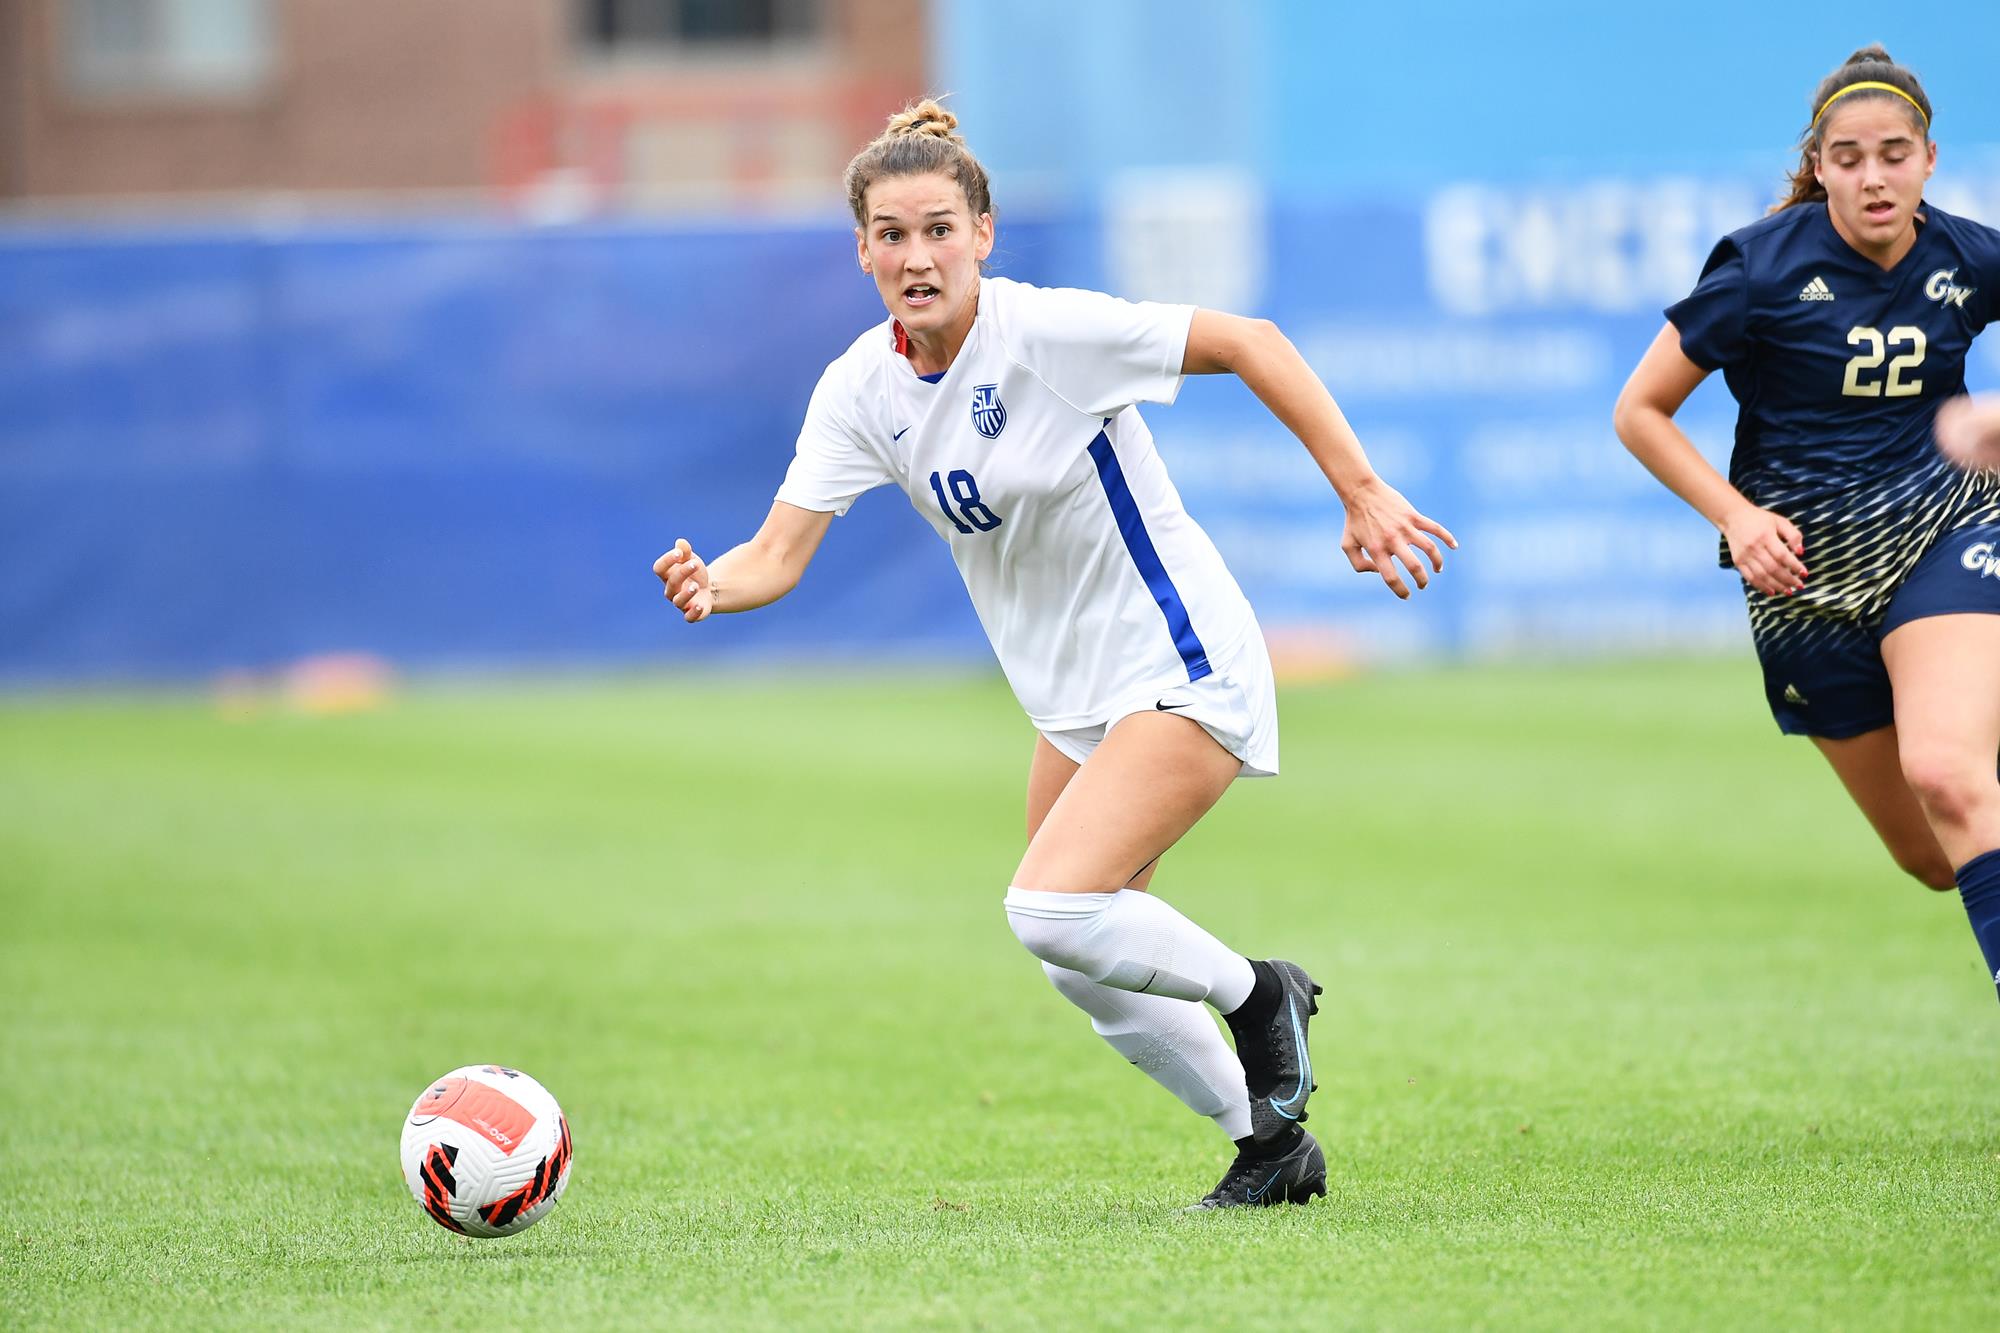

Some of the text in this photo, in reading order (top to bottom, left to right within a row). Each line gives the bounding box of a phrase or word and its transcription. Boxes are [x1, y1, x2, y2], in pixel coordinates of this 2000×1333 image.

[1799, 292, 1835, 302] adidas
[1923, 268, 1977, 309] GW
[1842, 326, 1926, 397] 22
[930, 469, 1002, 534] 18
